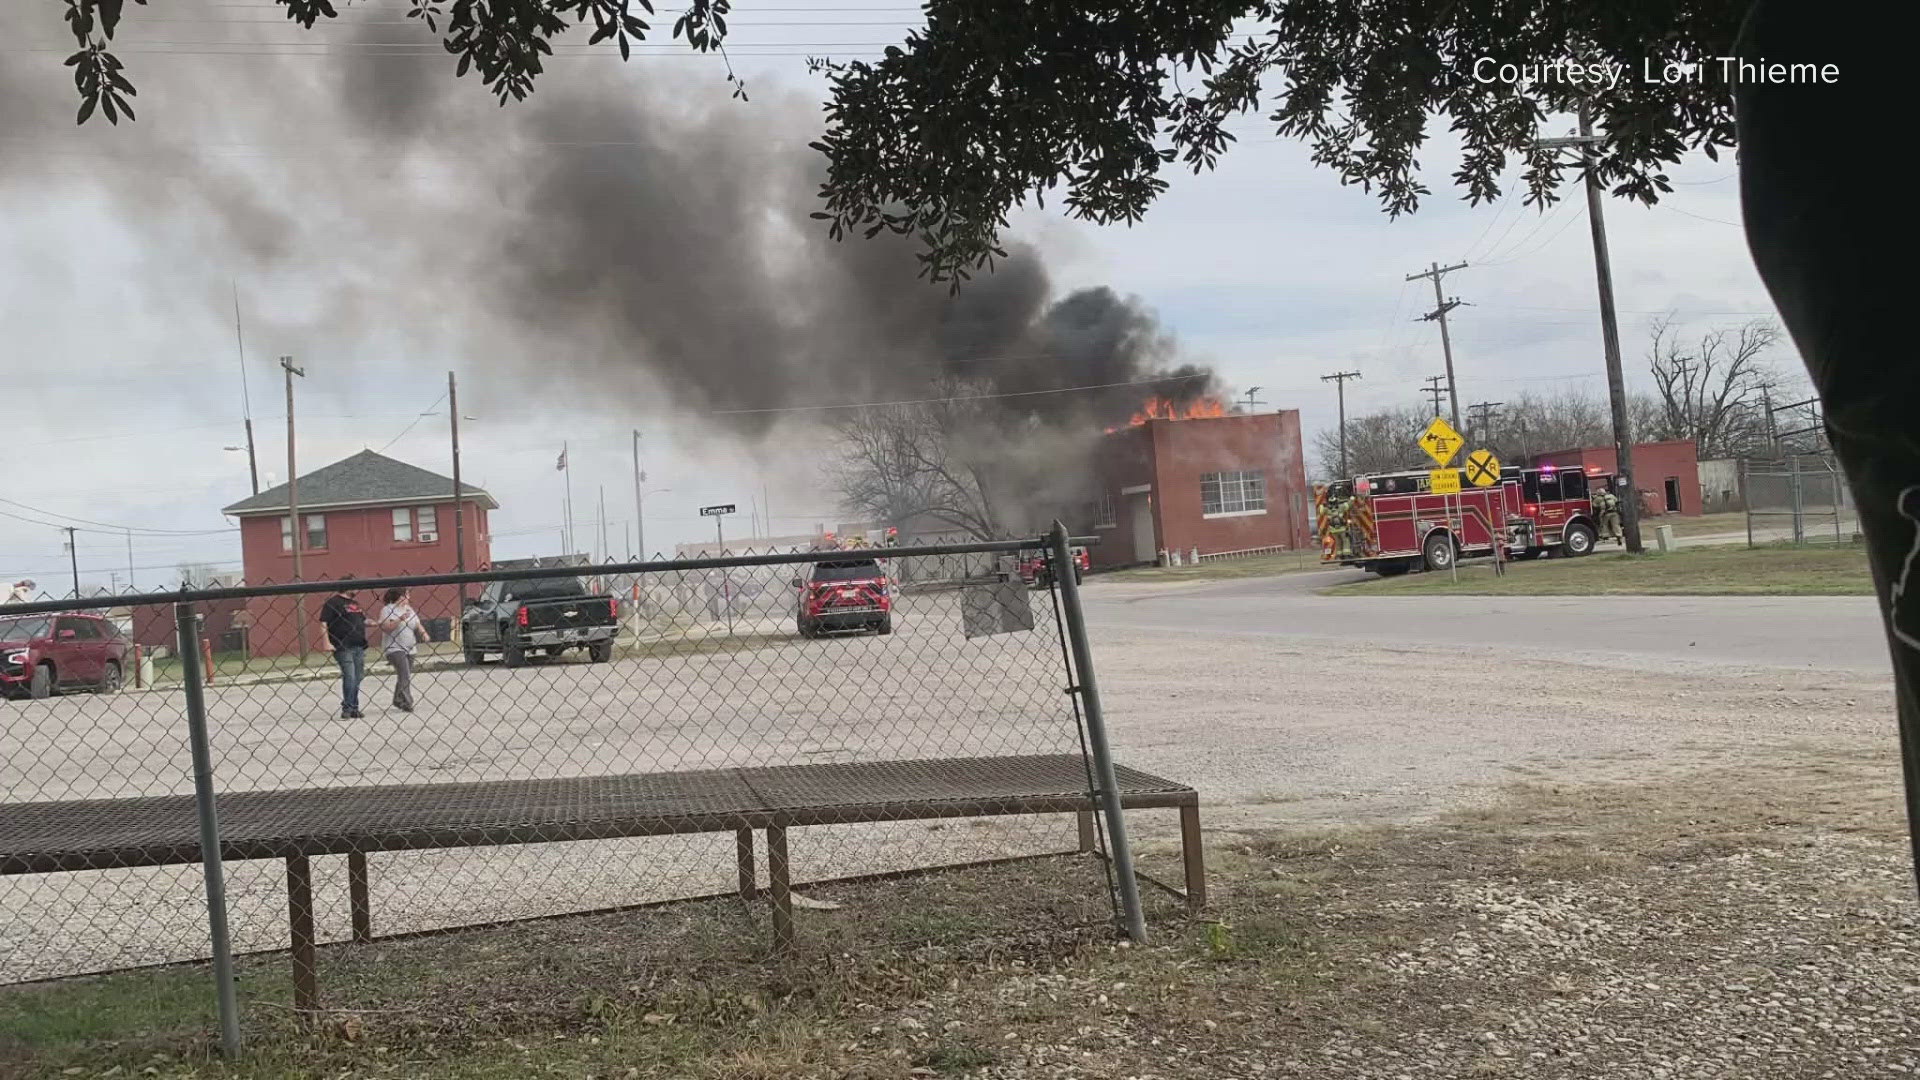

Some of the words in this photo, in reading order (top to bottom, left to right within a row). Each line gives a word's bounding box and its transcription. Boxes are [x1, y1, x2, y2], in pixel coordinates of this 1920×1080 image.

[1468, 465, 1476, 473] R
[1489, 463, 1497, 471] R
[703, 507, 728, 516] Emma
